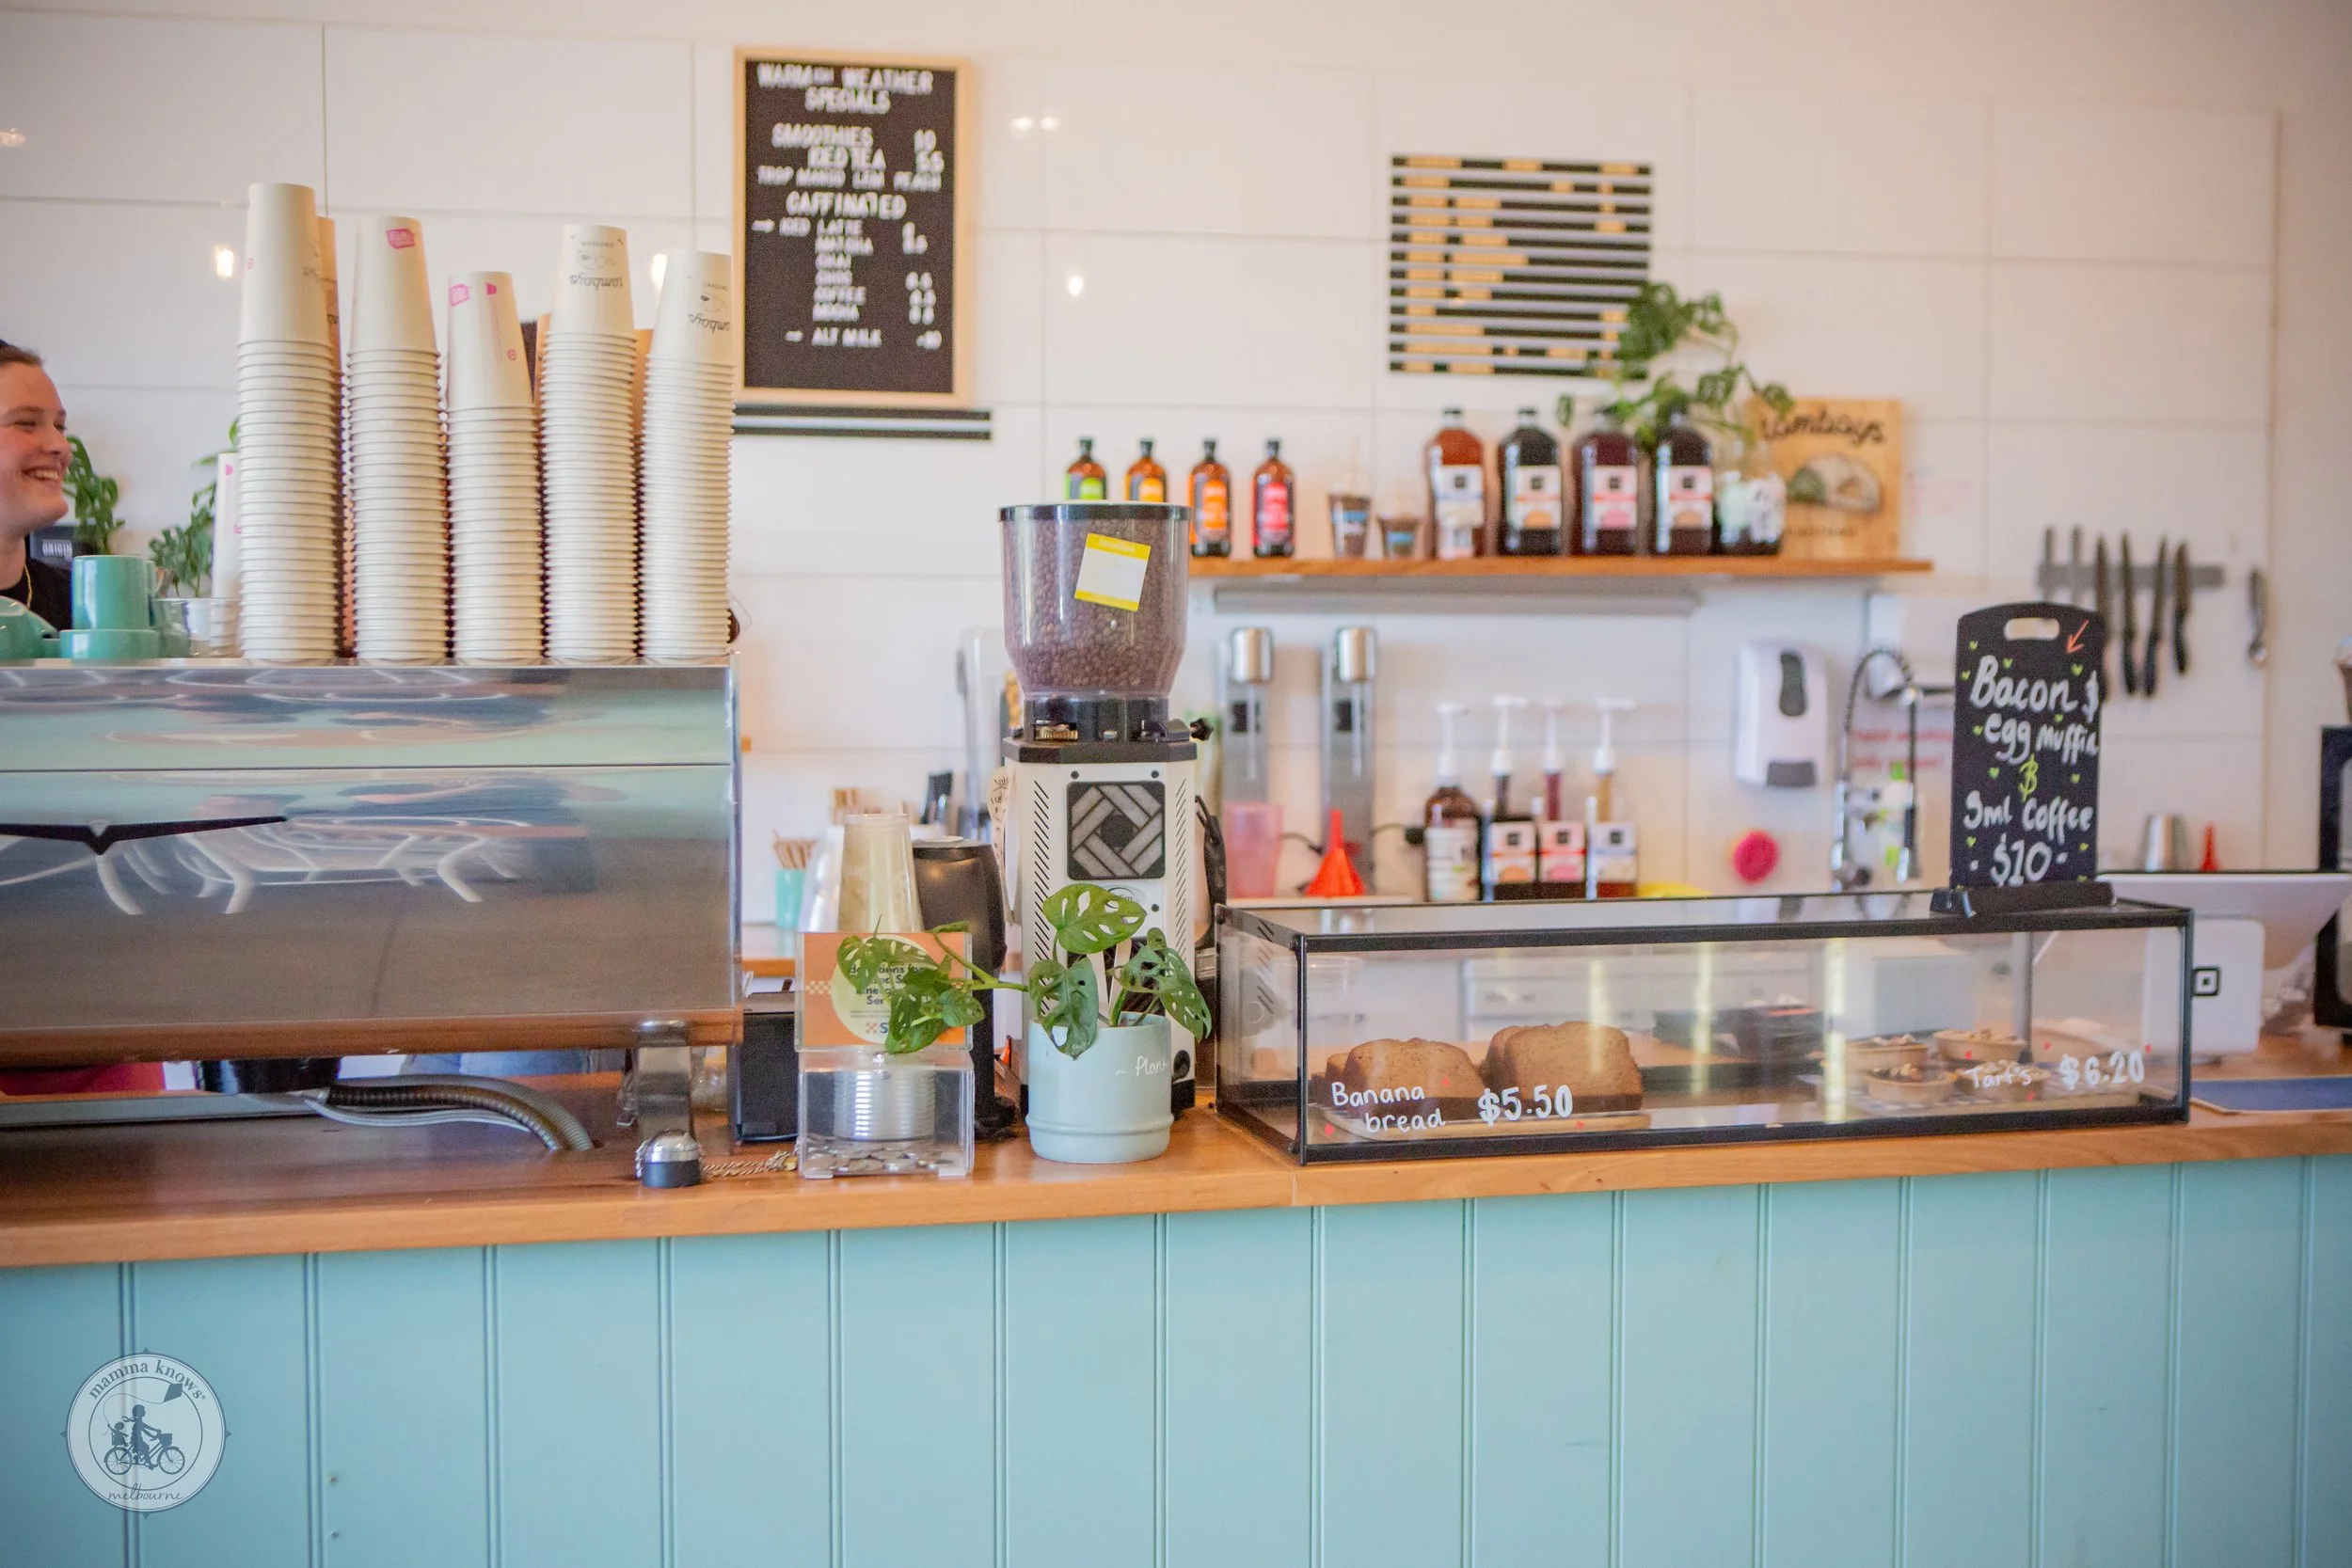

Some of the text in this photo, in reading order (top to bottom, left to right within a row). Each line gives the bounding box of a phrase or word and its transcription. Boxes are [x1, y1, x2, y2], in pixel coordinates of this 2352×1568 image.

[840, 67, 934, 96] WEATHER
[804, 86, 891, 115] SPECIALS
[771, 122, 874, 149] SMOOTHIES
[806, 145, 847, 169] ICED
[850, 147, 886, 171] TEA
[786, 190, 907, 220] CAFFINATED
[816, 217, 864, 237] LATTE
[1969, 655, 2078, 712] Bacon
[1983, 713, 2032, 767] egg
[2058, 1050, 2145, 1091] $6.20
[1330, 1082, 1573, 1127] Banana $5.50
[1365, 1108, 1446, 1133] bread
